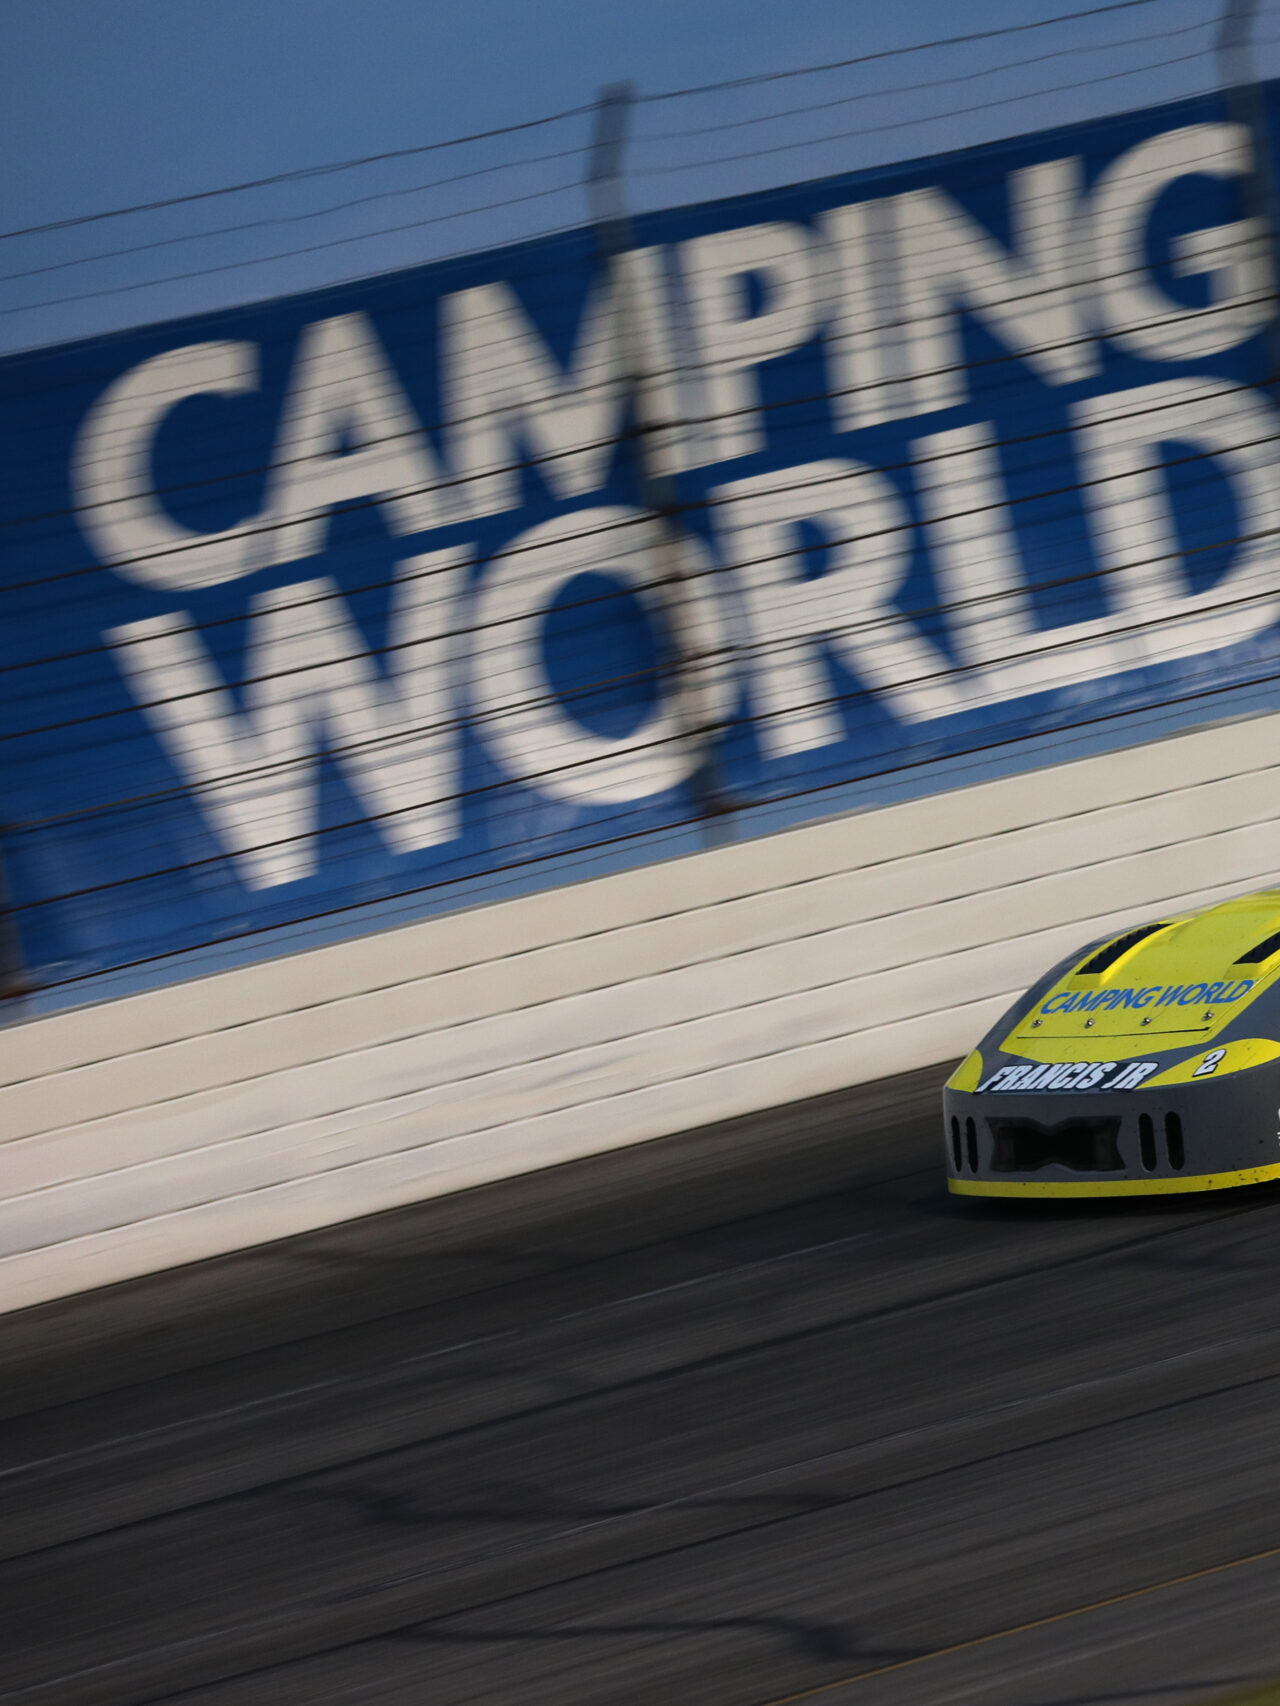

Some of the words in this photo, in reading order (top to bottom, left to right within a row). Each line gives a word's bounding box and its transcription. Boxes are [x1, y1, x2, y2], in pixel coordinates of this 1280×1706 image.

[71, 121, 1280, 592] CAMPING
[1040, 985, 1162, 1014] CAMPING
[1154, 979, 1255, 1007] WORLD
[975, 1061, 1112, 1093] FRANCIS
[1102, 1061, 1158, 1091] JR
[1193, 1049, 1226, 1077] 2
